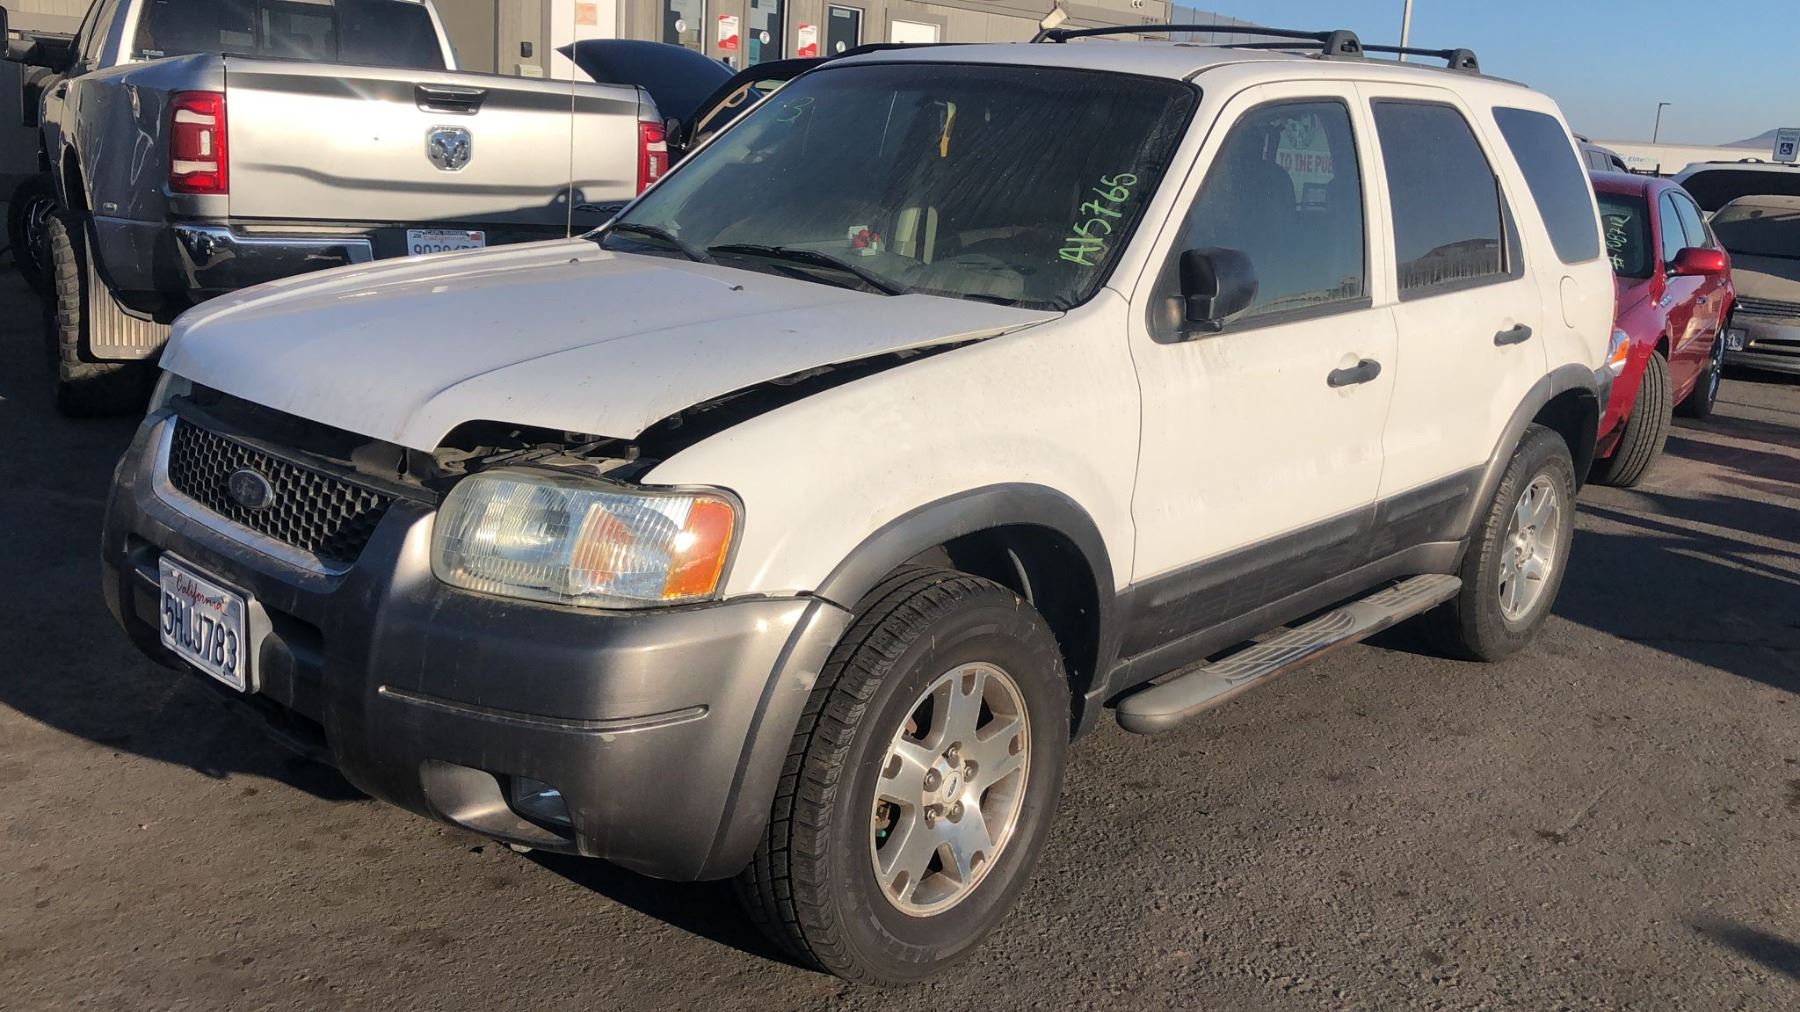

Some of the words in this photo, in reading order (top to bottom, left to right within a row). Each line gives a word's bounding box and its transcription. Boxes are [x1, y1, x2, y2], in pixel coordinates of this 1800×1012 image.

[1295, 152, 1313, 173] THE
[175, 573, 225, 610] California
[164, 590, 239, 674] 5HJJ783
